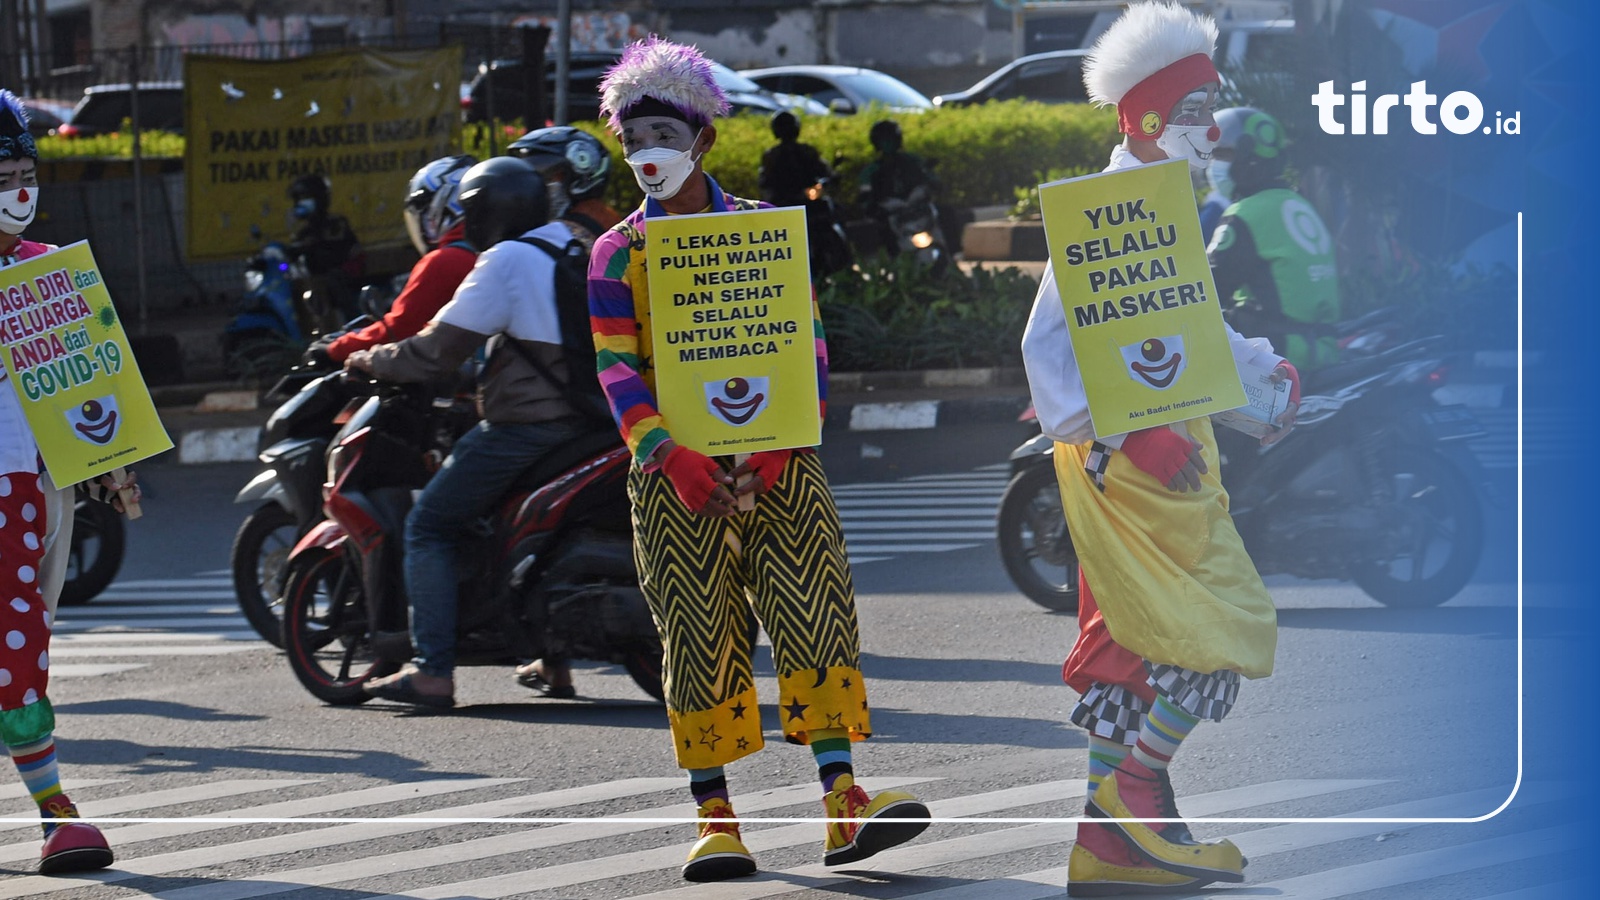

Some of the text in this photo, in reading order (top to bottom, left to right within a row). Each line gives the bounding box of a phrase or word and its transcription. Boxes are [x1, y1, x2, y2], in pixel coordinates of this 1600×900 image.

[210, 129, 278, 152] PAKAI
[287, 122, 367, 148] MASKER
[209, 161, 270, 183] TIDAK
[277, 157, 331, 180] PAKAI
[336, 151, 397, 174] MASKER
[1084, 199, 1156, 230] YUK,
[677, 233, 742, 249] LEKAS
[749, 229, 787, 244] LAH
[1066, 225, 1177, 266] SELALU
[660, 247, 792, 269] PULIH WAHAI
[694, 268, 768, 286] NEGERI
[1089, 257, 1177, 293] PAKAI
[0, 270, 99, 316] AGA DIRI dan
[674, 285, 785, 306] DAN SEHAT
[1074, 282, 1206, 328] MASKER!
[0, 294, 91, 344] KELUARGA
[693, 305, 768, 323] SELALU
[666, 321, 797, 344] UNTUK YANG
[10, 324, 91, 372] ANDA dari
[679, 341, 778, 362] MEMBACA
[21, 341, 121, 400] COVID-19
[1129, 395, 1213, 419] Aku Badut Indonesia
[1249, 397, 1278, 414] MASK
[744, 434, 776, 442] Indonesia
